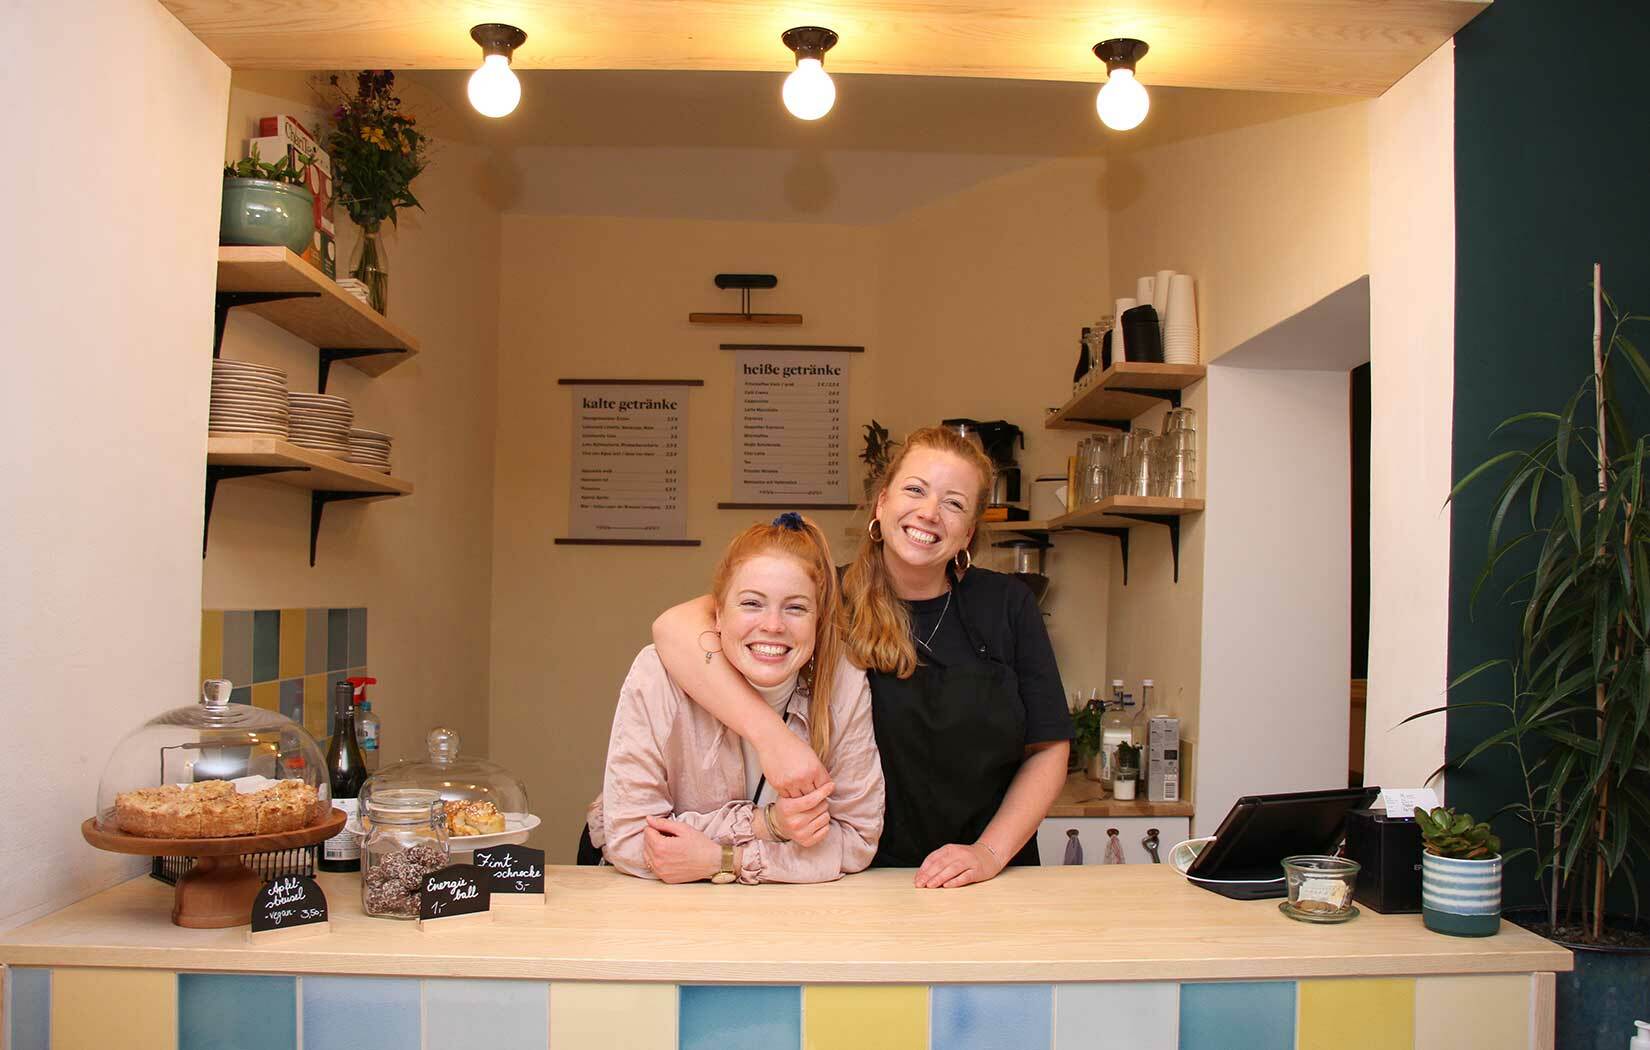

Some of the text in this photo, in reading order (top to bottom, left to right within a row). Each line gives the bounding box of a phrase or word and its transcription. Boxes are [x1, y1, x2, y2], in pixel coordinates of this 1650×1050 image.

[743, 363, 841, 378] heiße getränke
[582, 397, 678, 412] kalte getränke
[453, 885, 478, 901] ball
